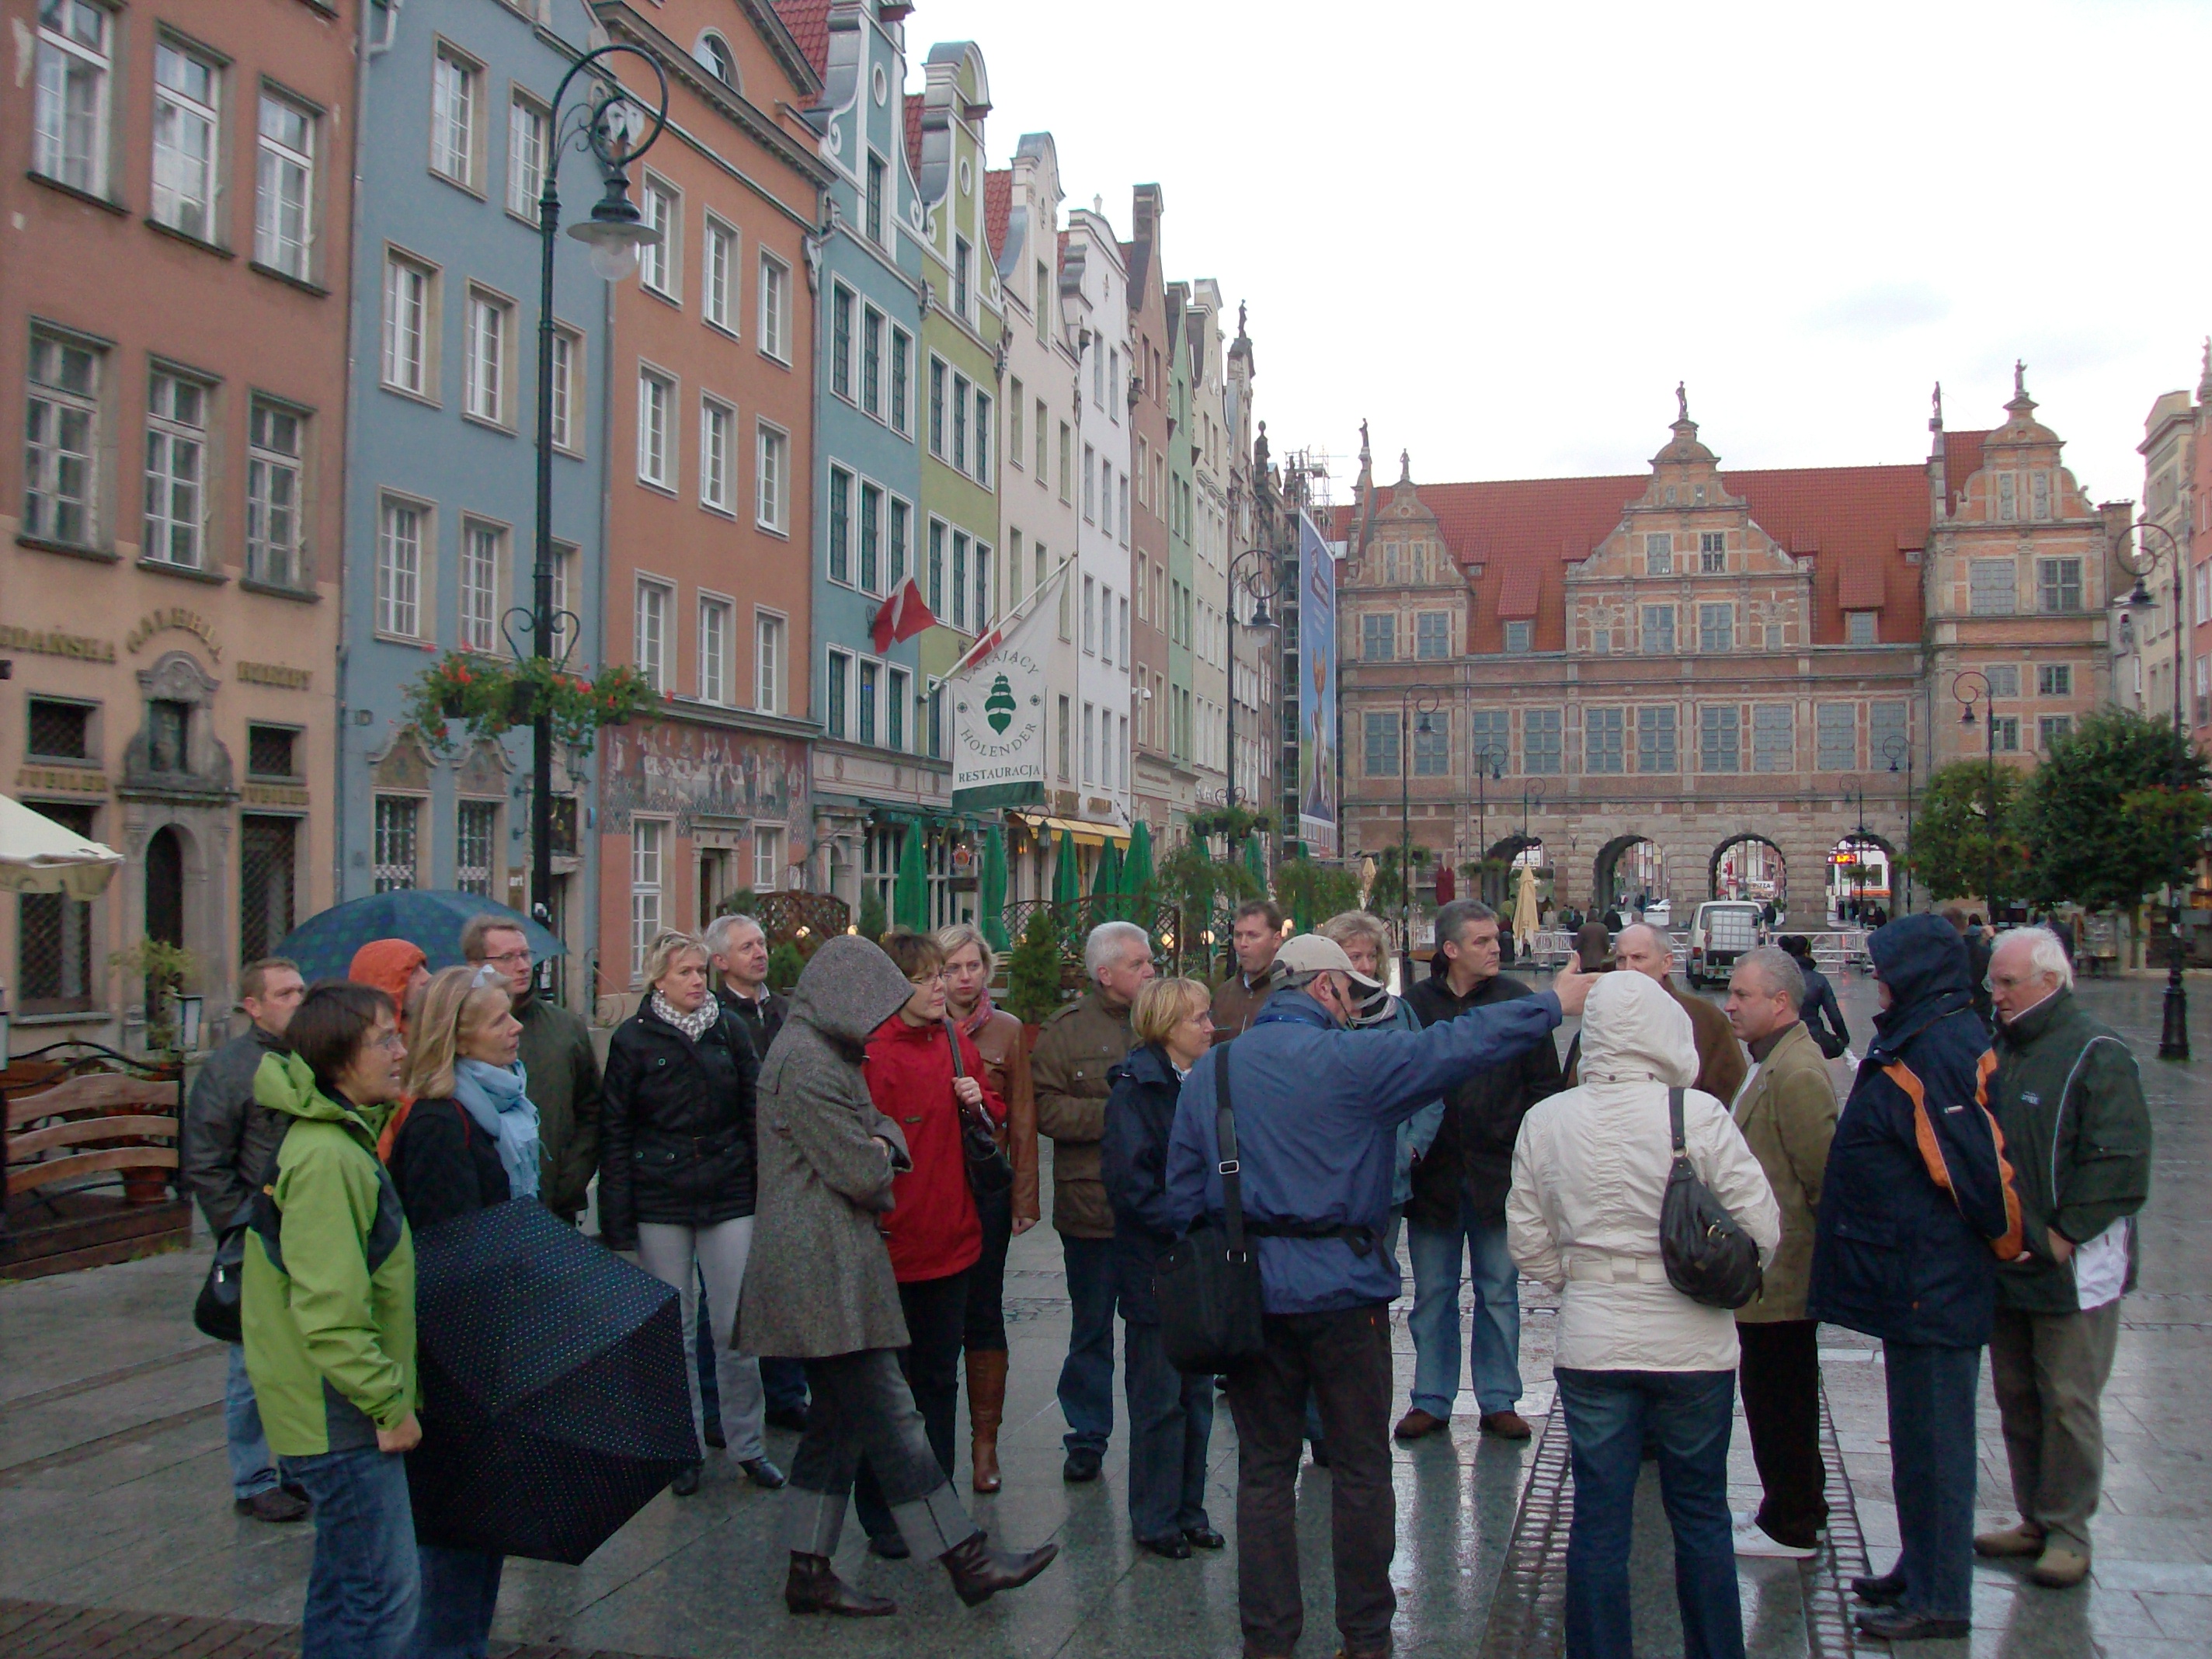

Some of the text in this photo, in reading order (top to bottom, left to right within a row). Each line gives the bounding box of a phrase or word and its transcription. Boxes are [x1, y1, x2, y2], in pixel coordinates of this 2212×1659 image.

[126, 607, 222, 665] GALERIA
[960, 723, 1037, 757] HOLENDER
[958, 764, 1040, 783] RESTAURACJA
